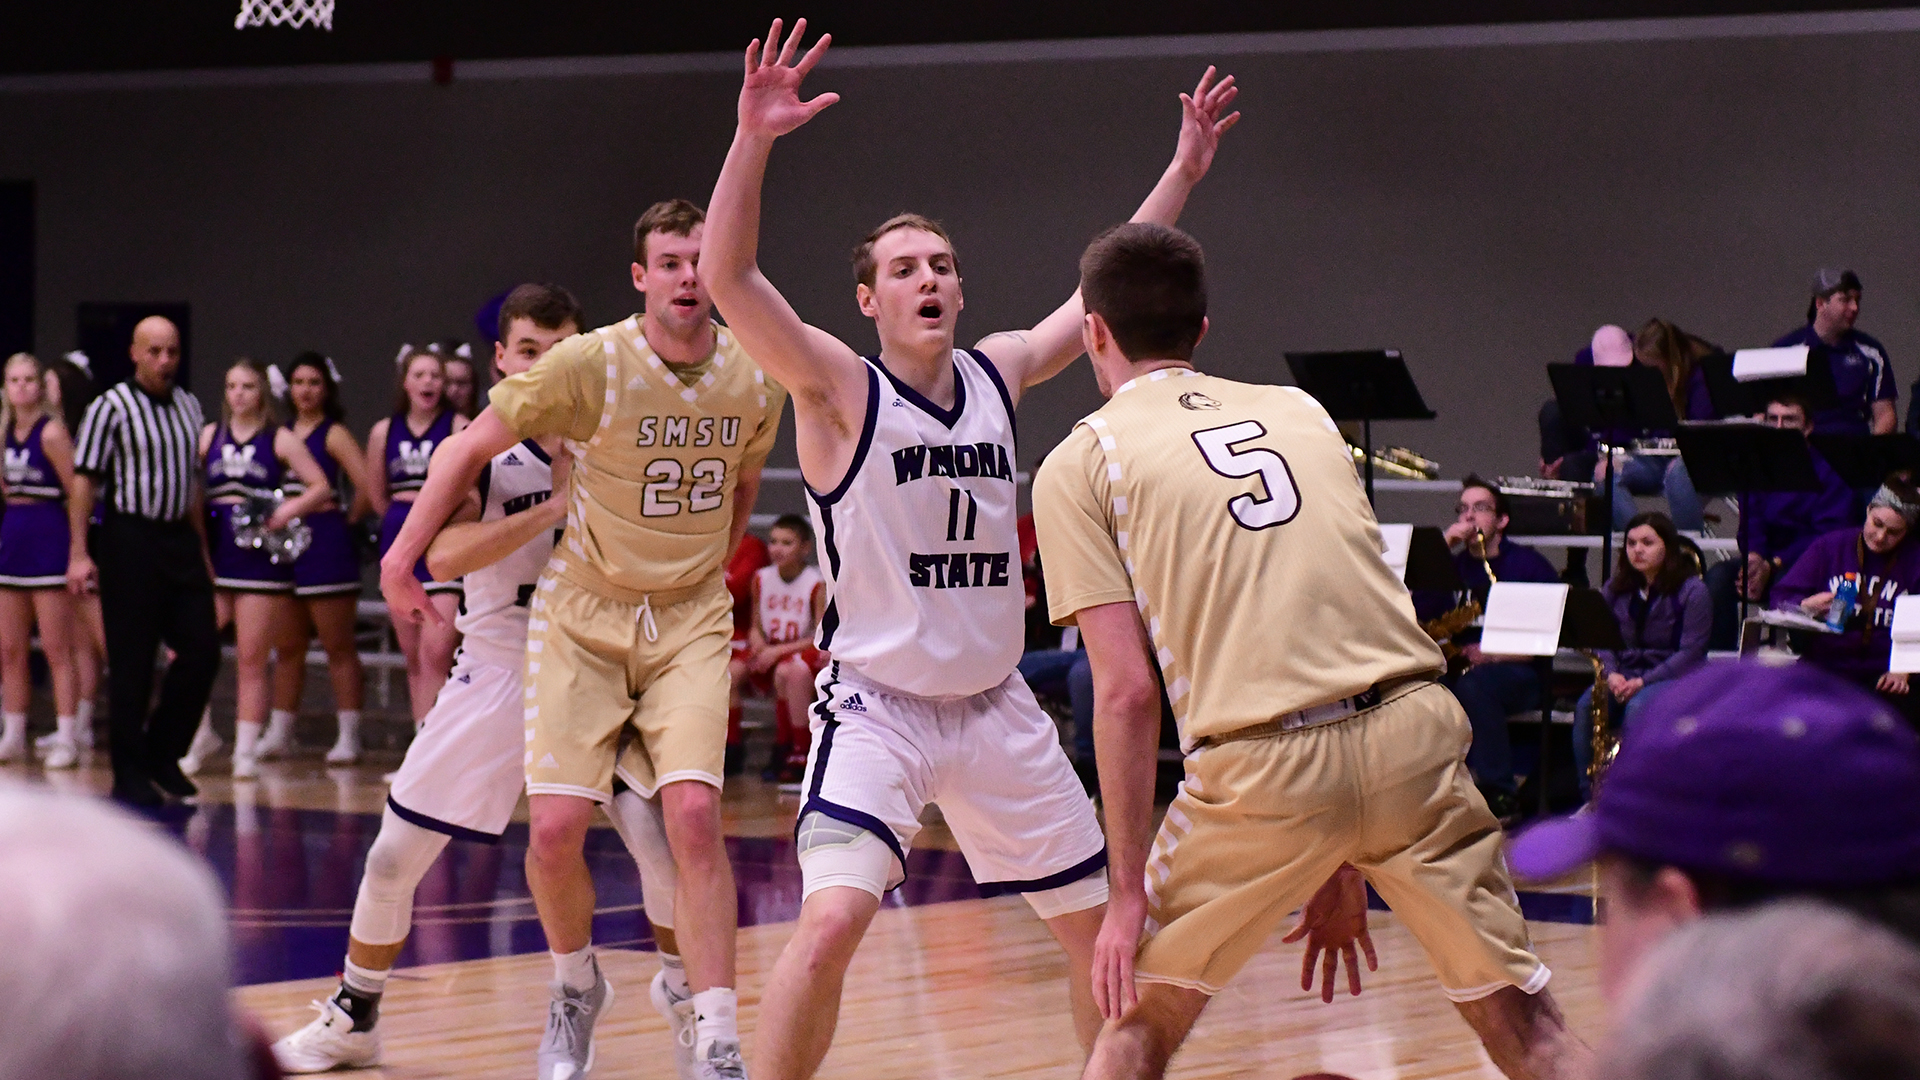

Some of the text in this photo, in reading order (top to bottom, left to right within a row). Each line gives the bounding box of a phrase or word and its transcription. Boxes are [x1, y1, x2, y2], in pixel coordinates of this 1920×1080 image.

[637, 415, 741, 447] SMSU
[641, 458, 726, 518] 22
[1190, 419, 1302, 531] 5
[946, 488, 978, 541] 11
[909, 552, 1009, 588] STATE
[770, 618, 799, 643] 20
